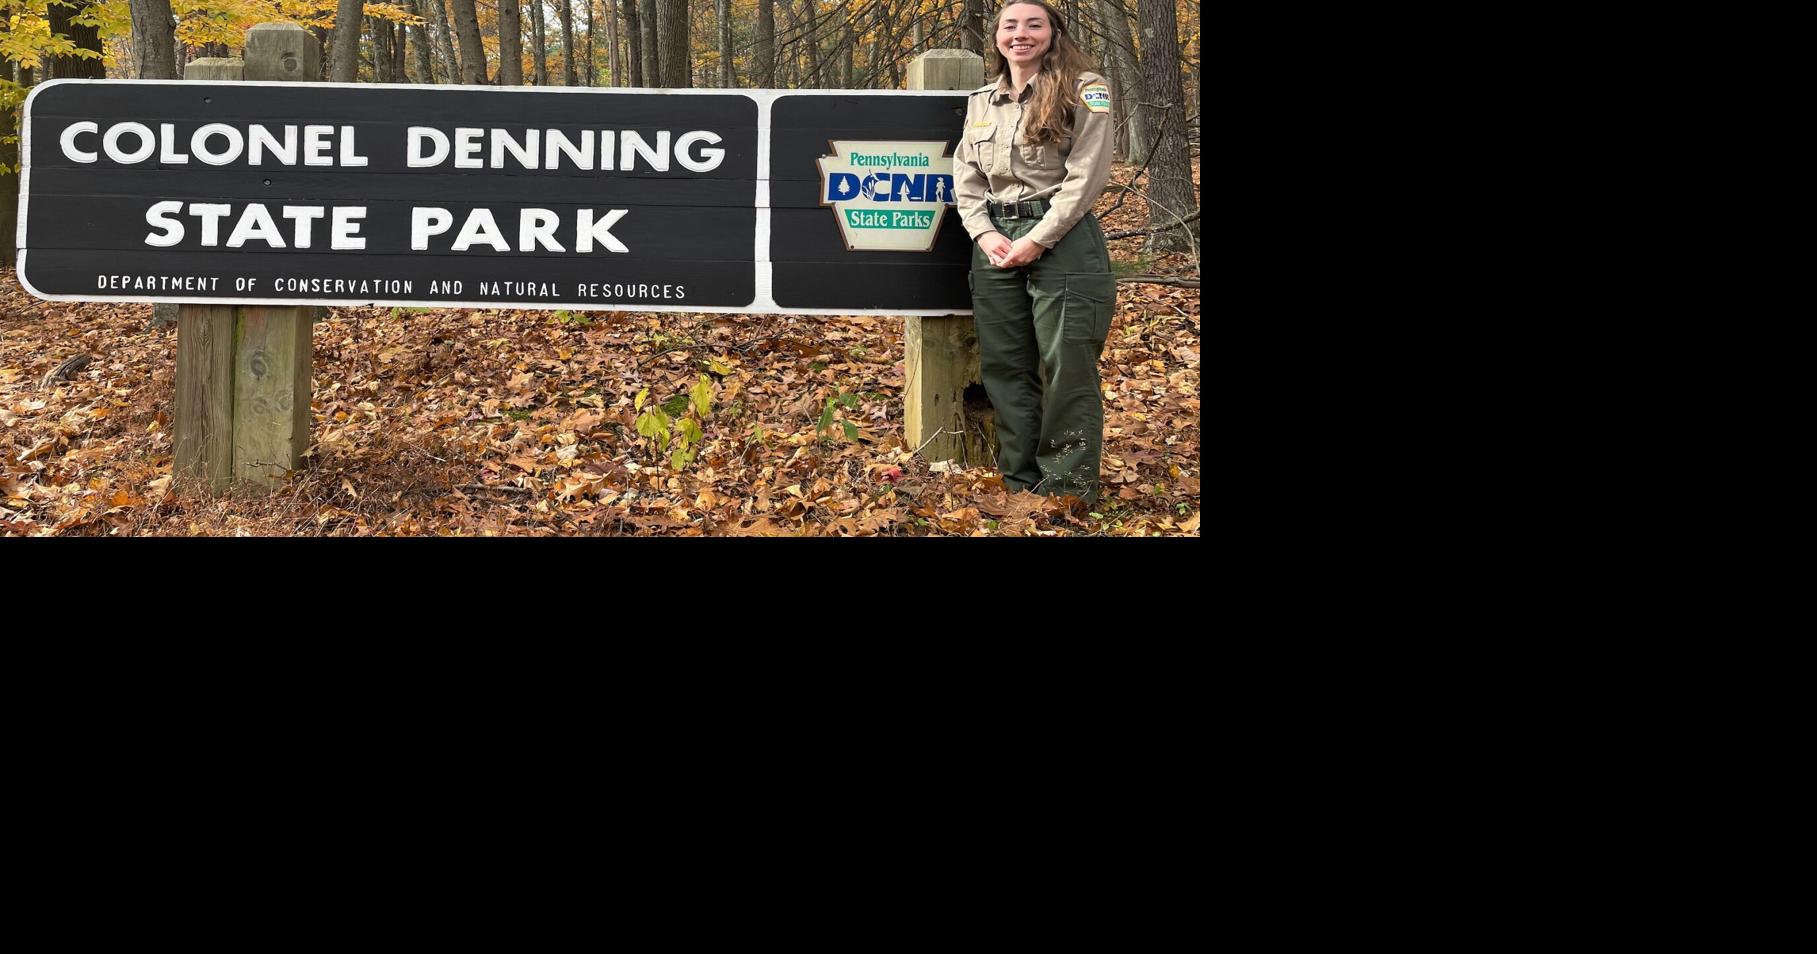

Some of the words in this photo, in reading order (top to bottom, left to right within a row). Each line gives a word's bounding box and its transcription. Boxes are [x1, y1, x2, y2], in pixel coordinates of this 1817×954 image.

[59, 121, 369, 167] COLONEL
[406, 126, 726, 173] DENNING
[850, 152, 930, 170] Pennsylvania
[827, 170, 954, 203] DCNR
[144, 200, 368, 250] STATE
[411, 206, 630, 253] PARK
[850, 210, 888, 228] State
[892, 212, 930, 228] Parks
[97, 274, 220, 292] DEPARTMENT
[235, 277, 257, 293] OF
[274, 277, 413, 295] CONSERVATION
[429, 280, 463, 296] AND
[479, 281, 561, 298] NATURAL
[578, 283, 686, 300] RESOURCES
